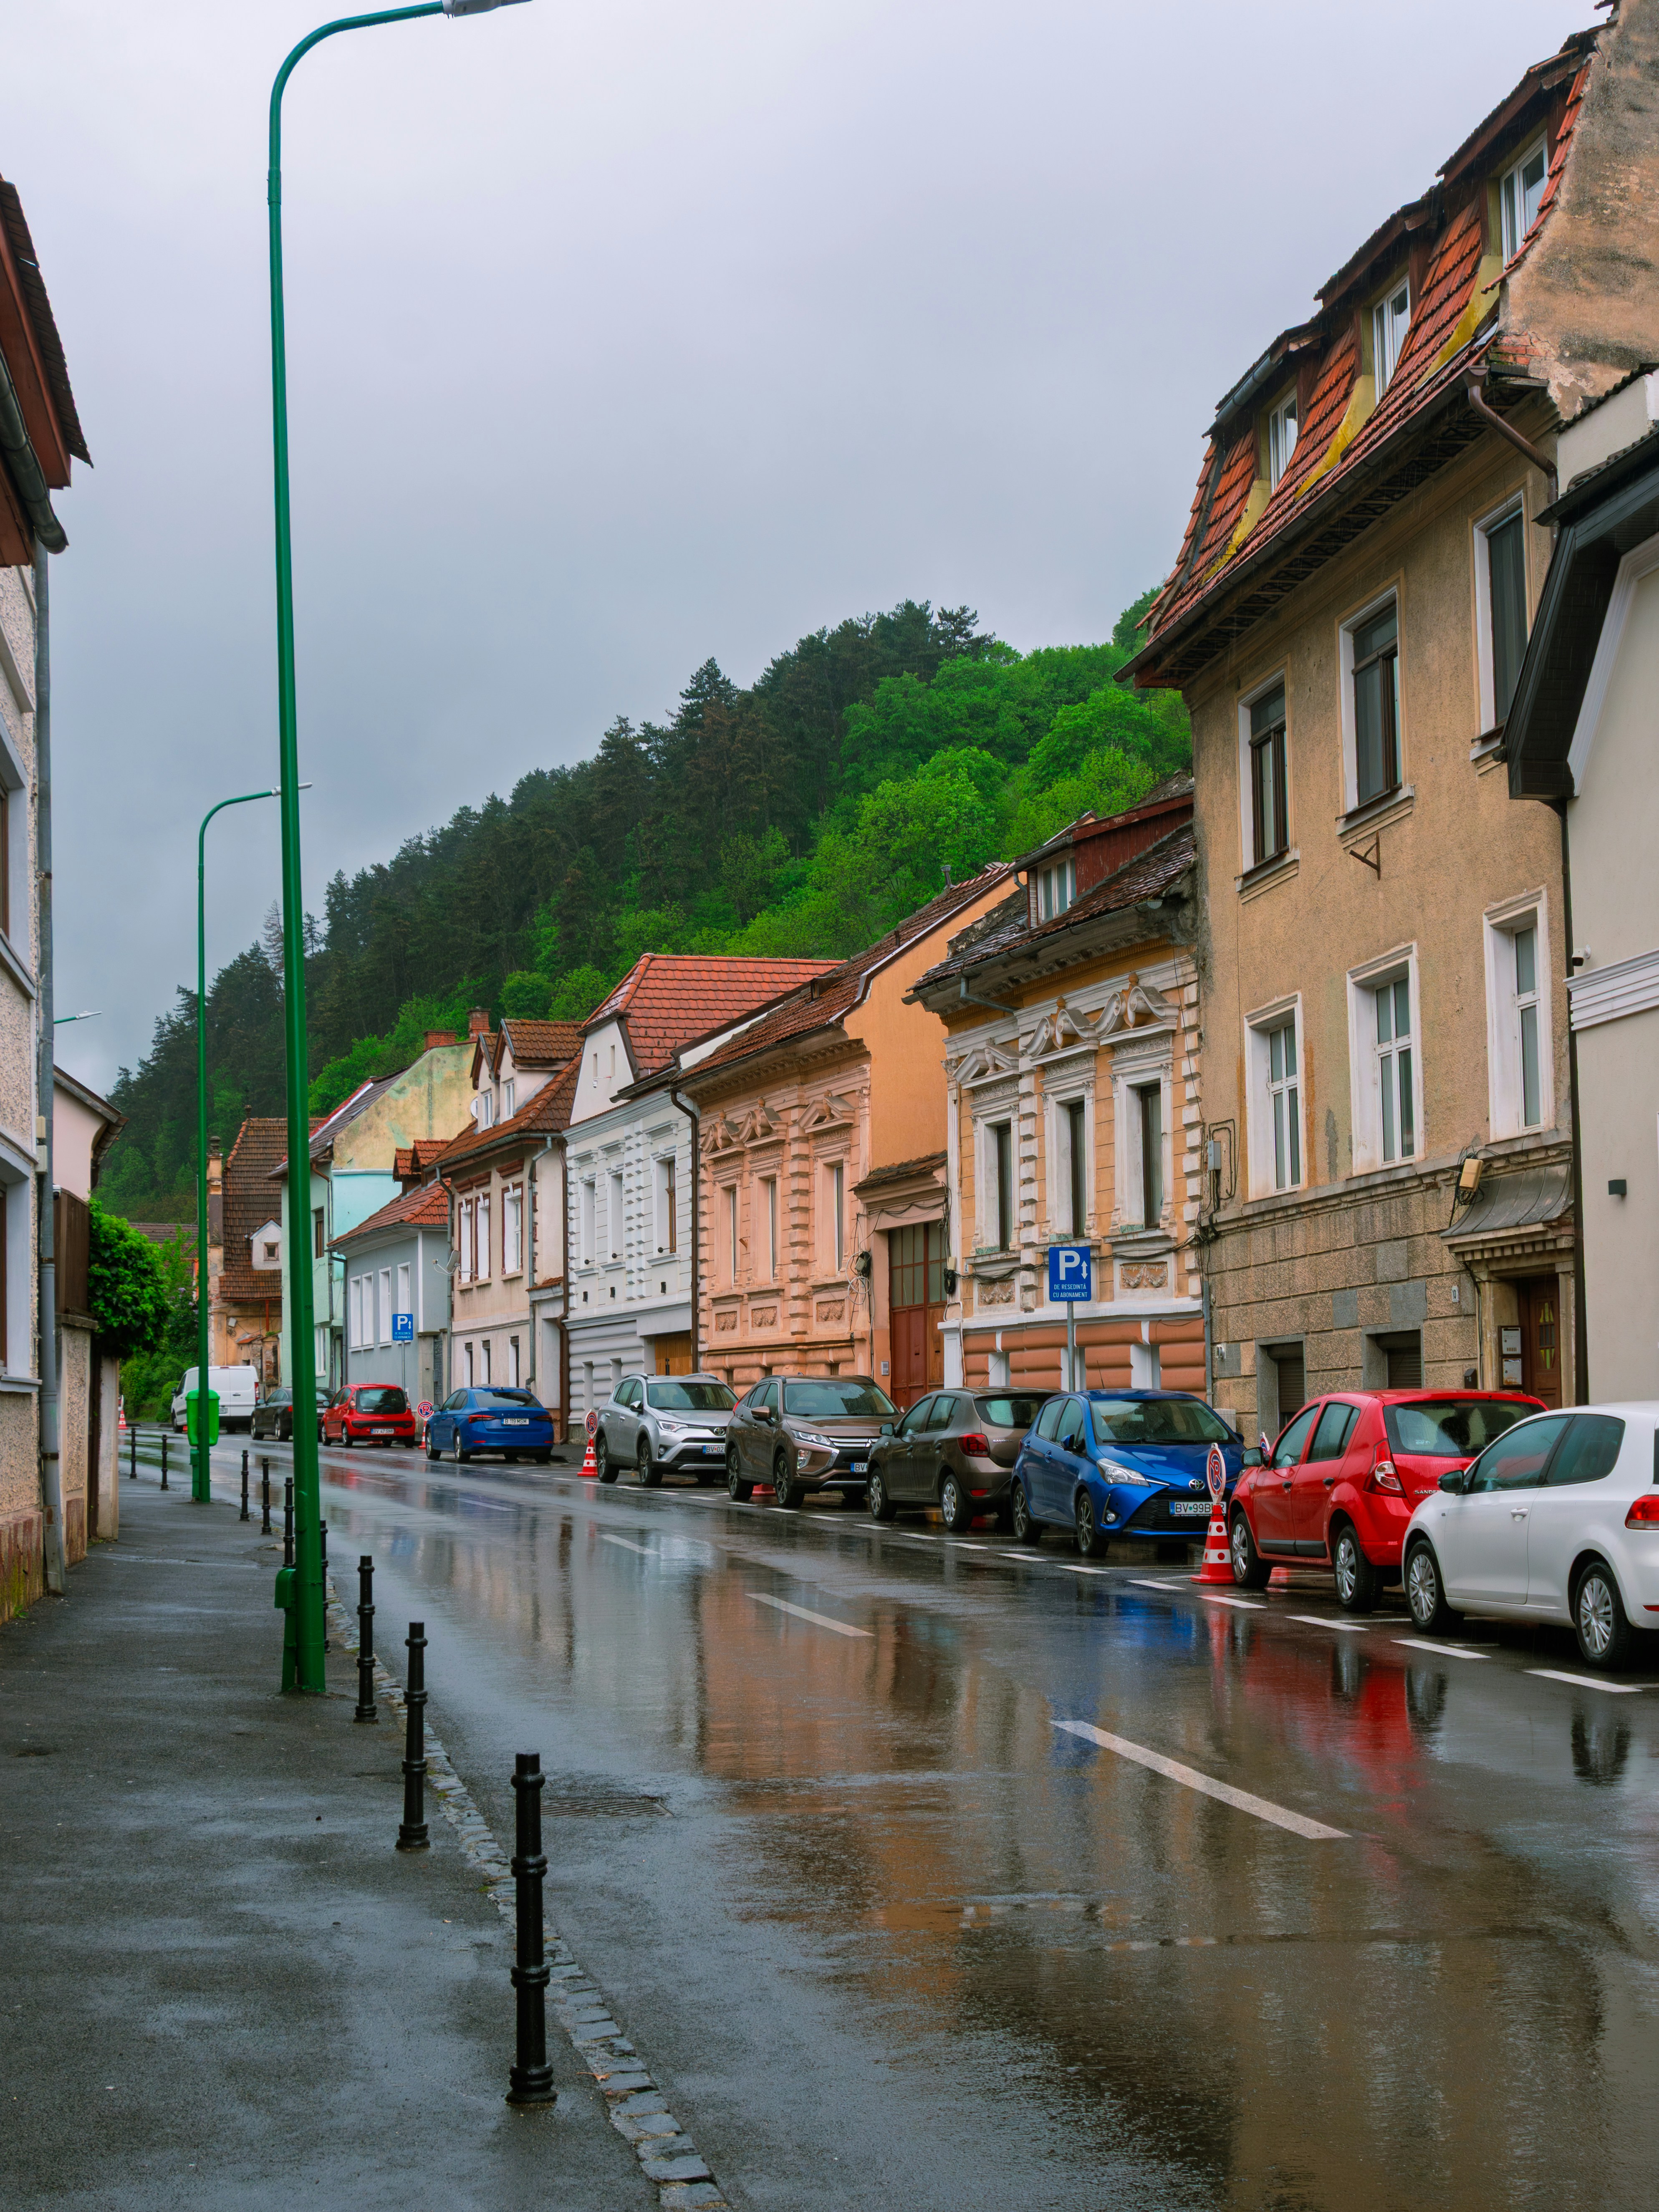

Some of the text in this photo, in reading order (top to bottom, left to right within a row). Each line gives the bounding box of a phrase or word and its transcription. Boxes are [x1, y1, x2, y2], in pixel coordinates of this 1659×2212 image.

[1059, 1250, 1081, 1280] P
[1452, 1289, 1456, 1299] 10
[397, 1316, 408, 1330] P
[1175, 1503, 1189, 1513] BV
[1193, 1503, 1224, 1513] 99BR
